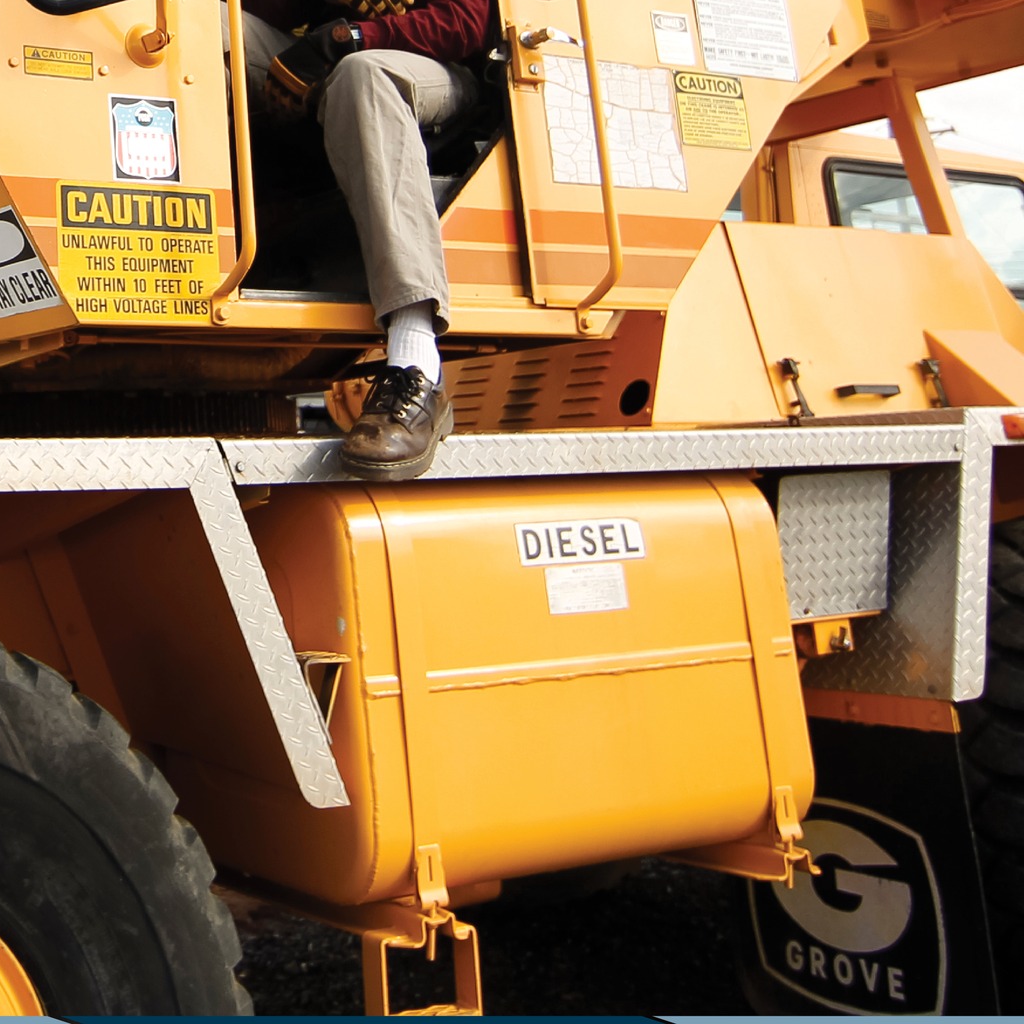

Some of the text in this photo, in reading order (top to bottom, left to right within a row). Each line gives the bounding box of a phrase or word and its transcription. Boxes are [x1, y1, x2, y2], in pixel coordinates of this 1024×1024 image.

[41, 50, 86, 61] CAUTION
[679, 76, 738, 95] CAUTION
[67, 191, 207, 229] CAUTION
[62, 234, 214, 254] UNLAWFUL TO OPERATE
[86, 256, 194, 273] THIS EQUIPMENT
[8, 269, 57, 304] CLEAR
[77, 277, 203, 294] WITHIN 10 FEET OF
[76, 298, 208, 314] HIGH VOLTAGE LINES
[521, 523, 640, 560] DIESEL
[785, 940, 905, 1000] GROVE
